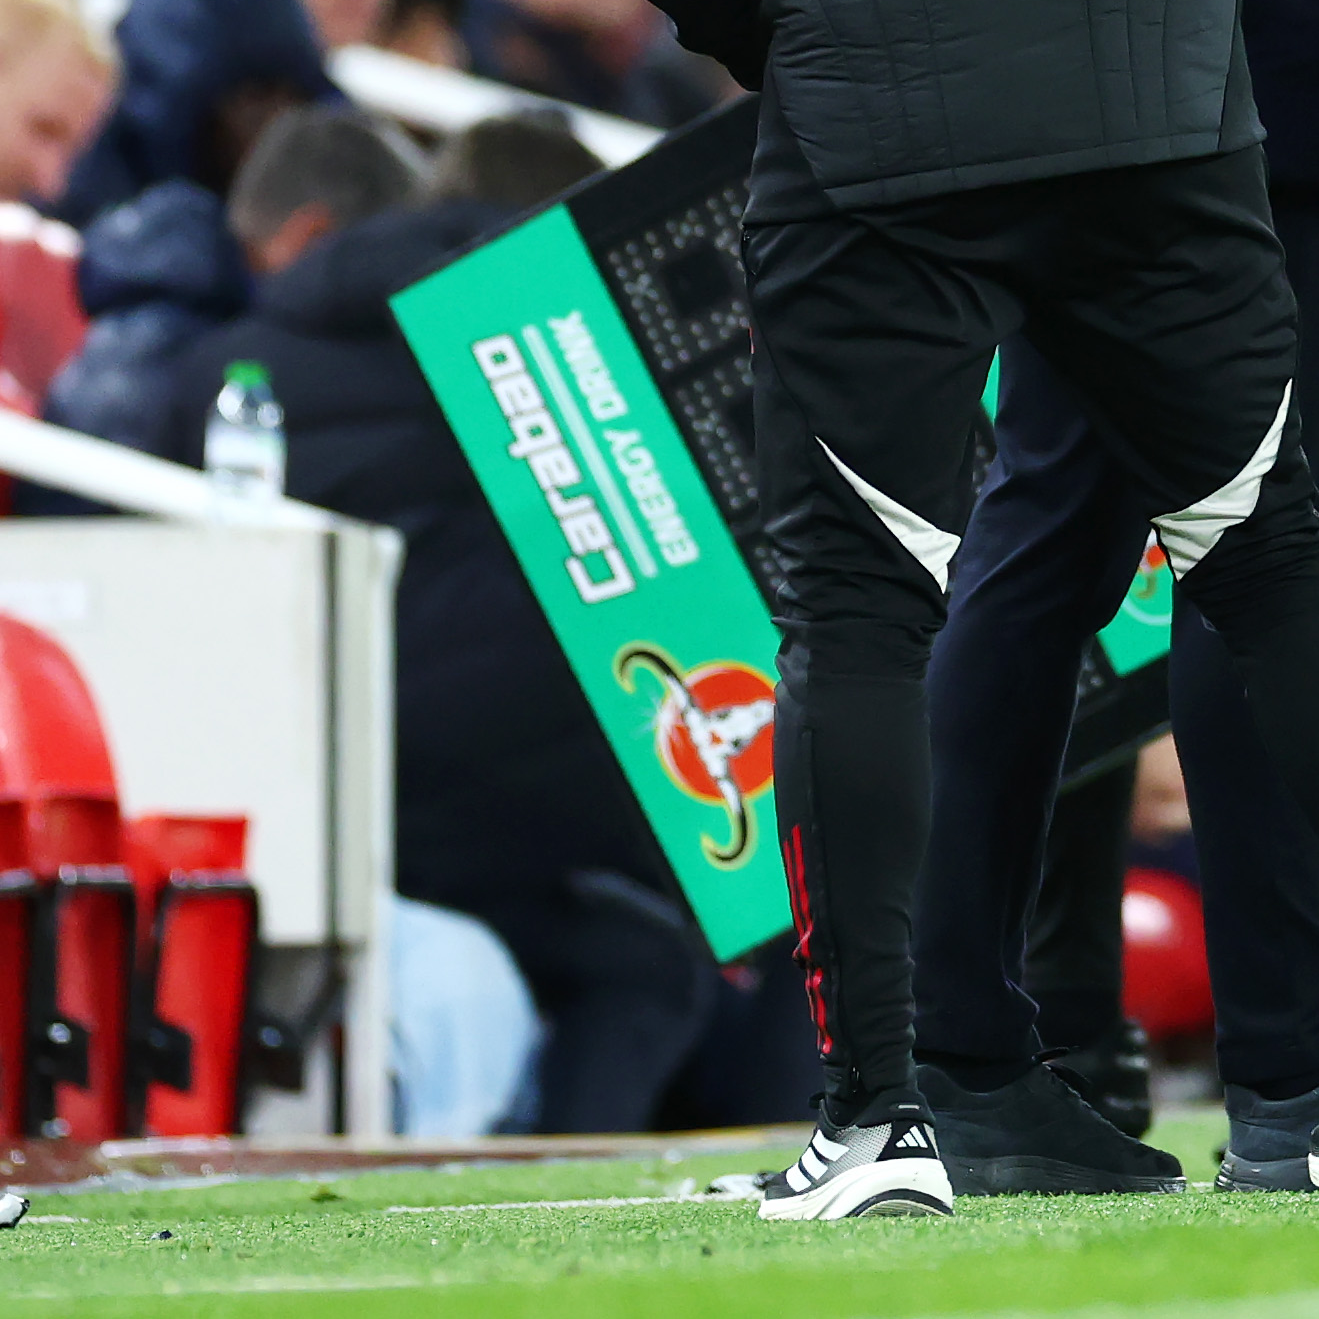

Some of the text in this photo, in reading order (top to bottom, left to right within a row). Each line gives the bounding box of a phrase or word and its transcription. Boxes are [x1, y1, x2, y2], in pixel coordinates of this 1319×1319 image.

[473, 334, 634, 603] Carabao
[548, 310, 699, 567] ENERGY DRINK
